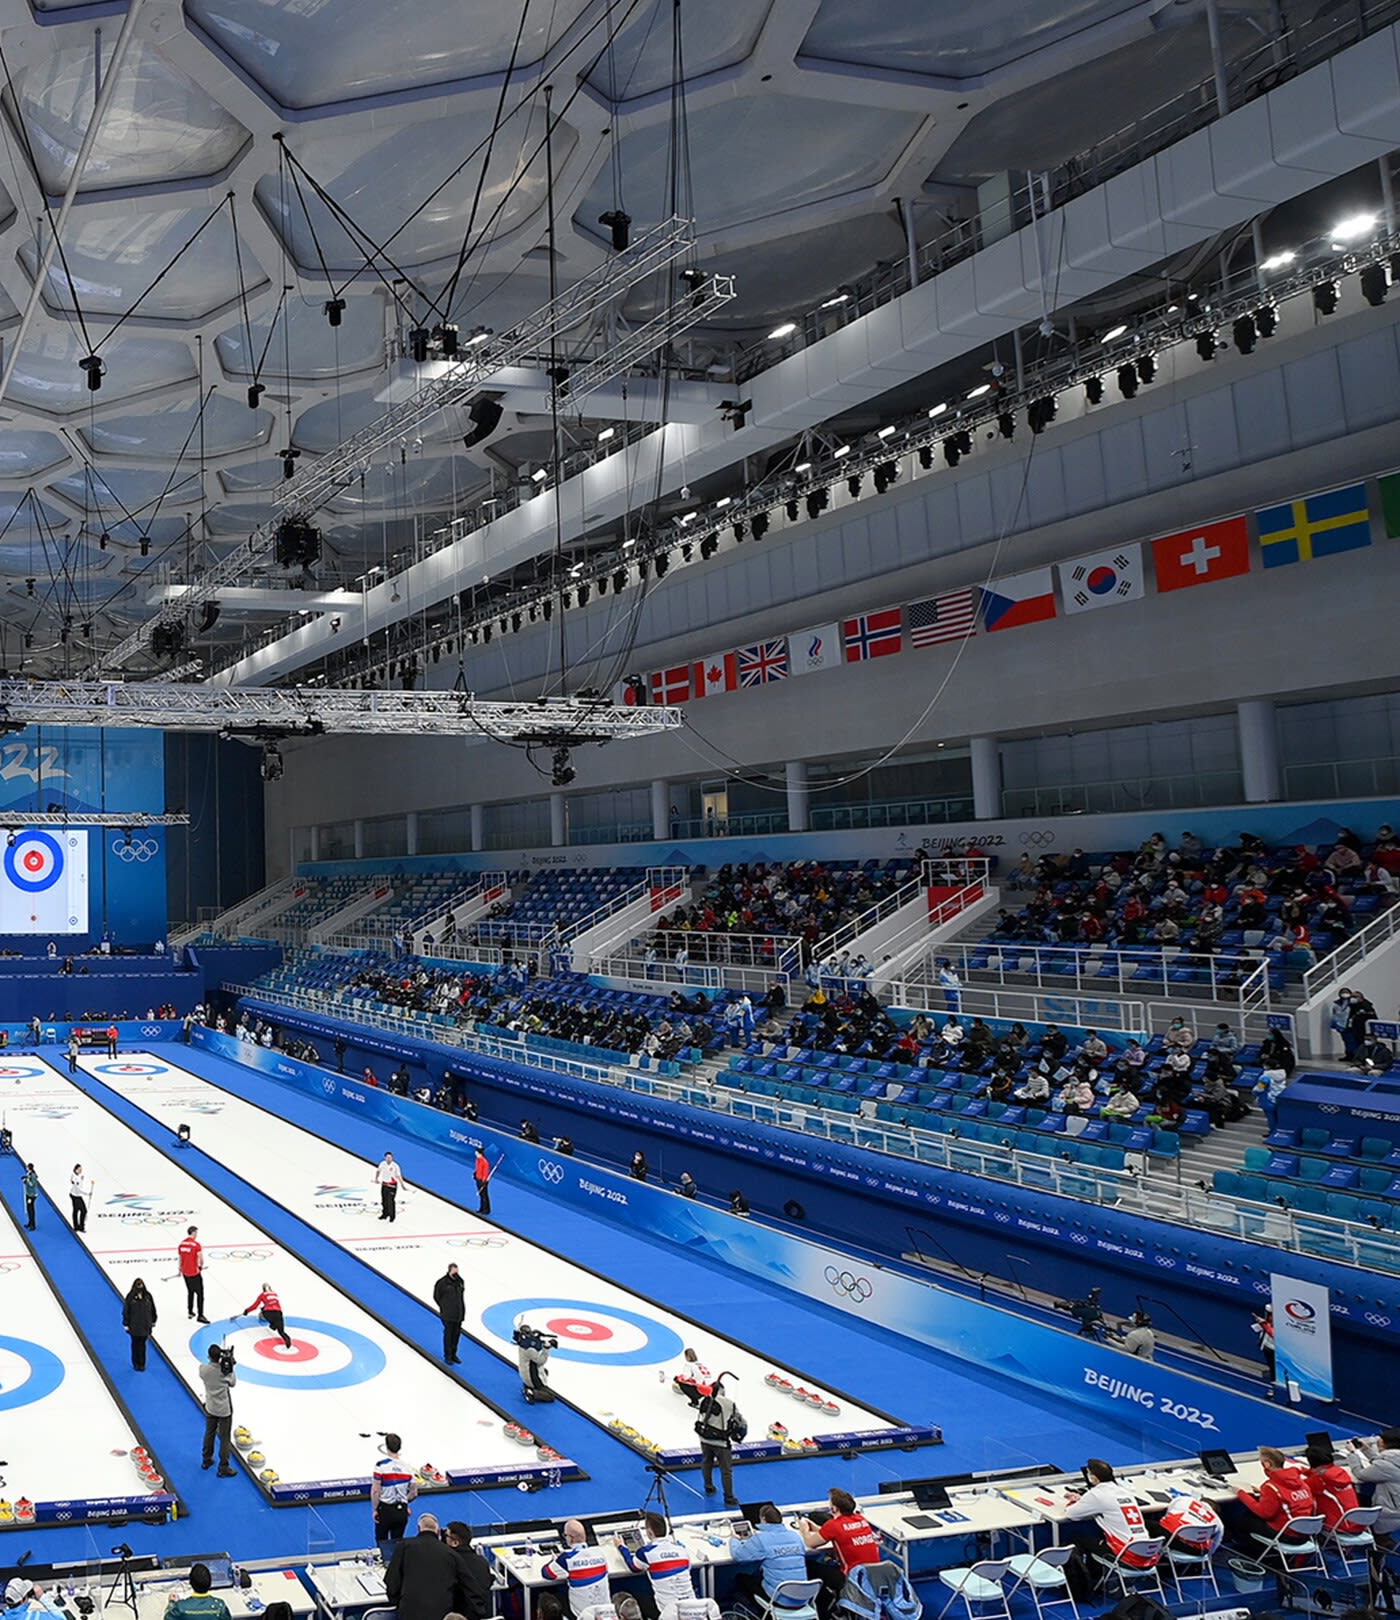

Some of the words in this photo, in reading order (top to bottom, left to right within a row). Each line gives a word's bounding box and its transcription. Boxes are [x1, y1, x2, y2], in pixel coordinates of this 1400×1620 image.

[921, 837, 965, 851] BEIJING
[967, 835, 1007, 846] 2022
[1351, 1108, 1382, 1120] BEIJING
[579, 1178, 605, 1198] BEIJING
[606, 1189, 629, 1206] 2022
[1017, 1218, 1041, 1231] BEIJING
[1041, 1224, 1060, 1236] 2022
[1096, 1239, 1123, 1254] BEIJING
[1123, 1247, 1144, 1259] 2022
[1185, 1263, 1215, 1279] BEIJING
[1216, 1272, 1240, 1285] 2022
[1329, 1303, 1351, 1315] 022
[1084, 1367, 1155, 1408] BEIJING
[1160, 1398, 1222, 1433] 2022
[87, 1510, 110, 1518] BEIJING
[111, 1508, 128, 1516] 2022
[660, 1551, 679, 1559] COACH
